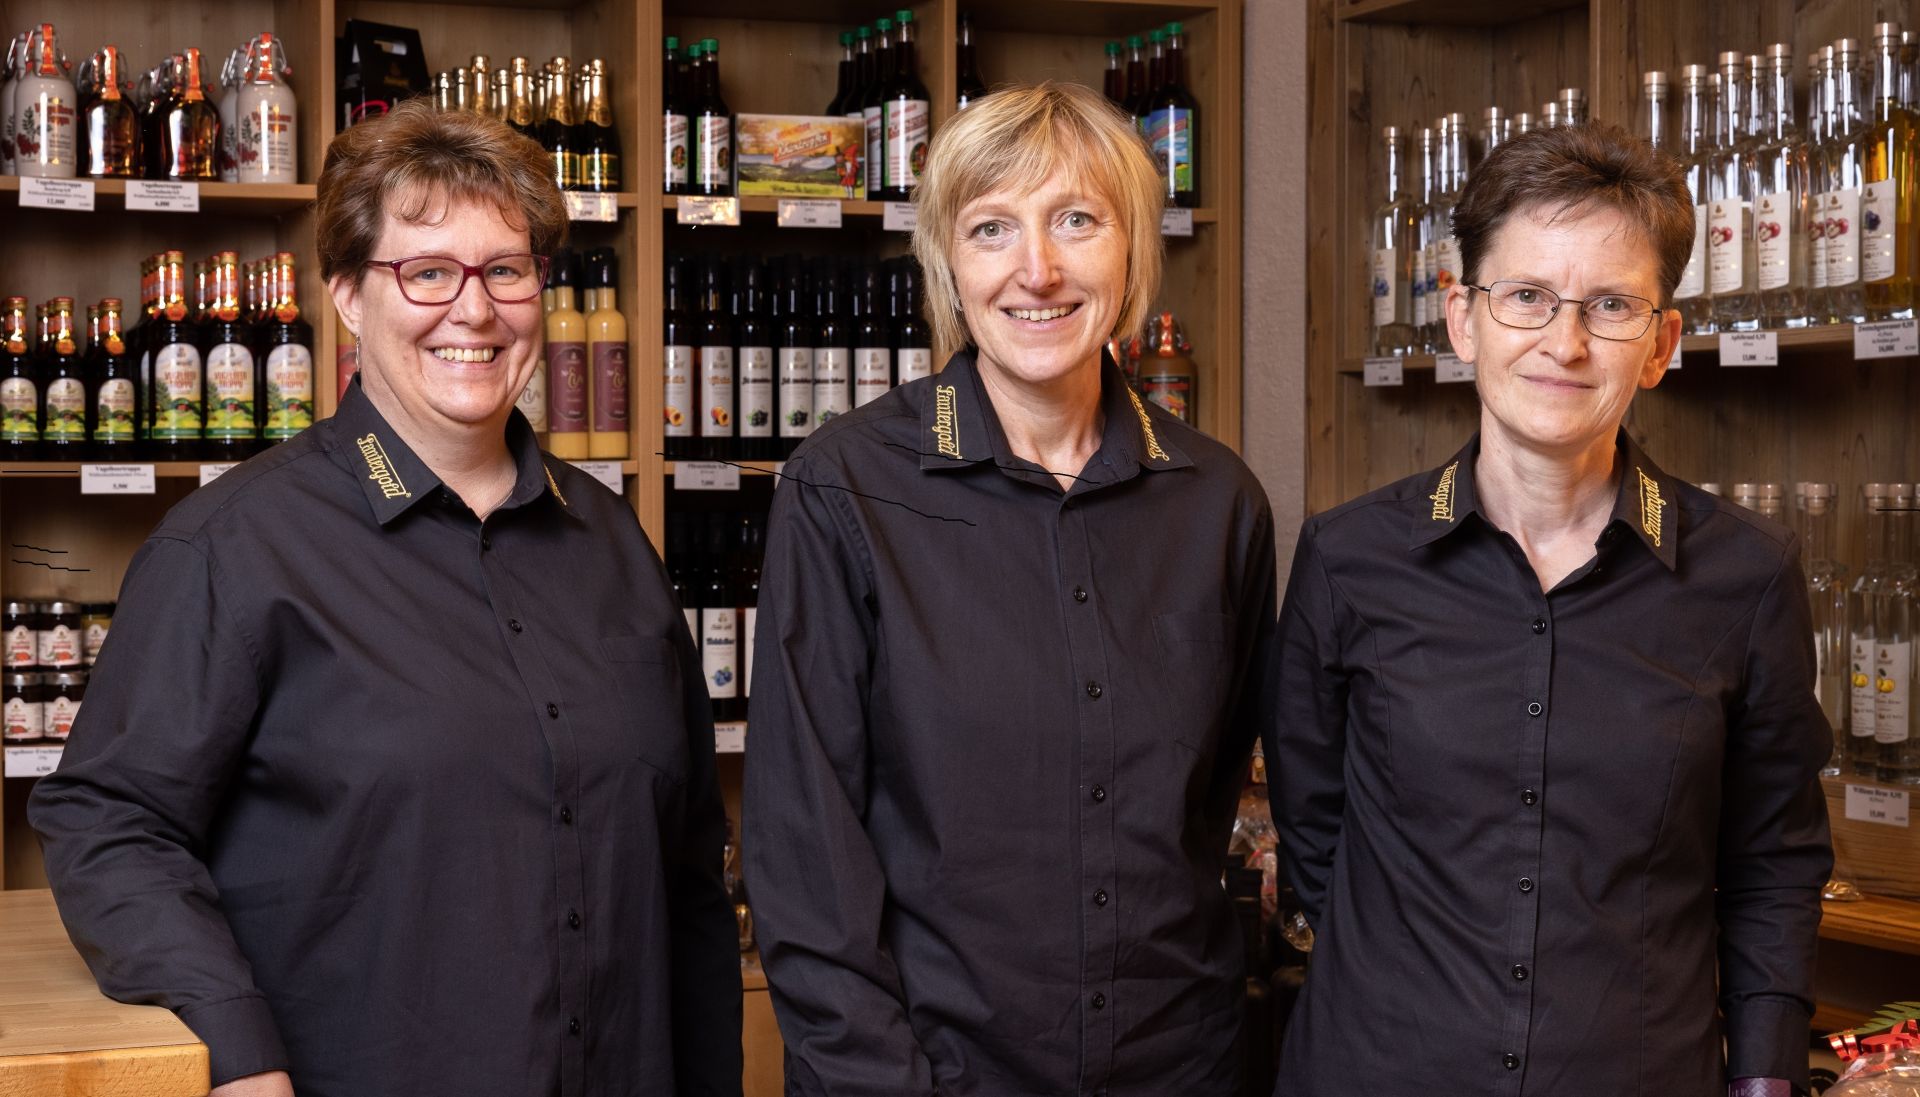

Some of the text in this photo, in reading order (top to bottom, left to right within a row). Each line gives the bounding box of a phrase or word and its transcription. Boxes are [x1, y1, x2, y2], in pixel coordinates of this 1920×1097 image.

[932, 385, 960, 456] Lautergold
[357, 433, 406, 499] Lautergold
[1429, 461, 1459, 521] Lautergold
[1639, 470, 1667, 547] Lautergold
